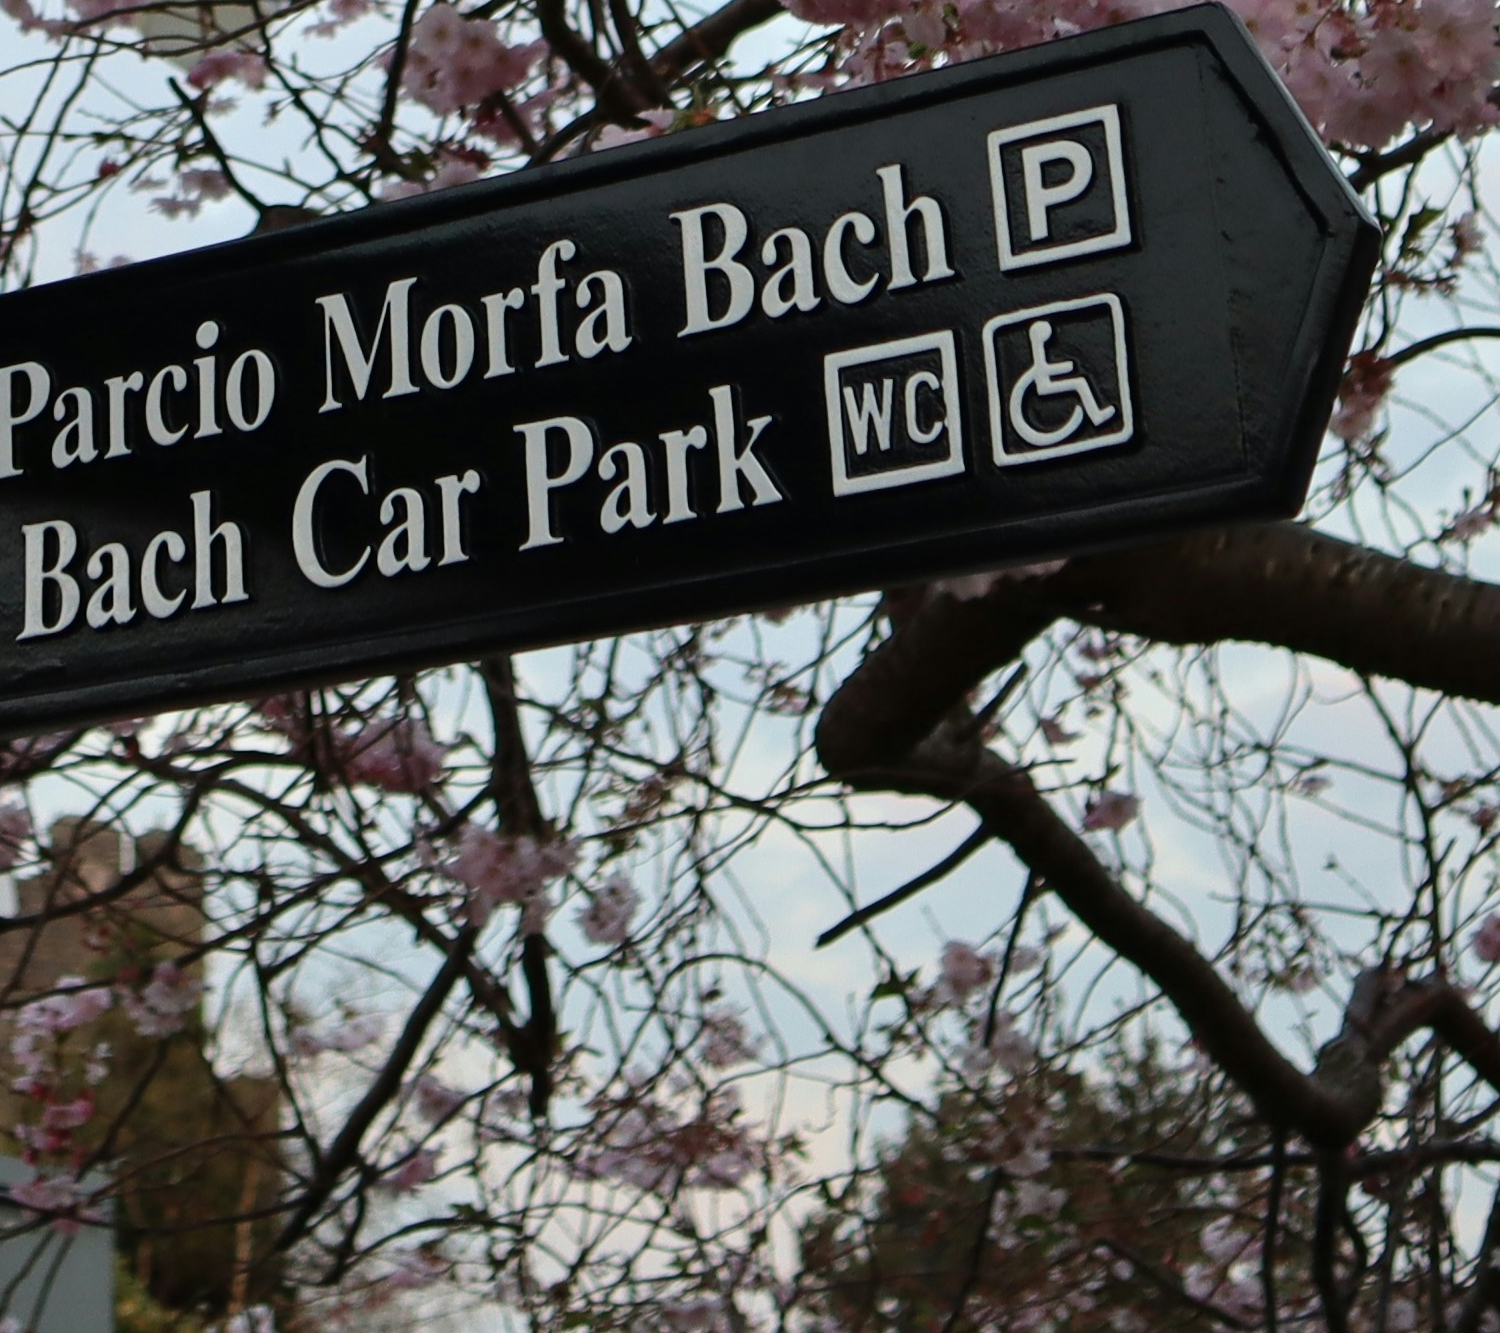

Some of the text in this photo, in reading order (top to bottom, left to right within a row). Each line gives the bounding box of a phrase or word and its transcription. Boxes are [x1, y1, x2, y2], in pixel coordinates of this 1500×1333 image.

[314, 238, 632, 415] Morfa
[670, 163, 954, 339] Bach
[1022, 138, 1093, 242] P
[16, 490, 249, 641] Bach
[292, 457, 484, 589] Car
[516, 383, 785, 552] Park
[842, 367, 946, 453] WC
